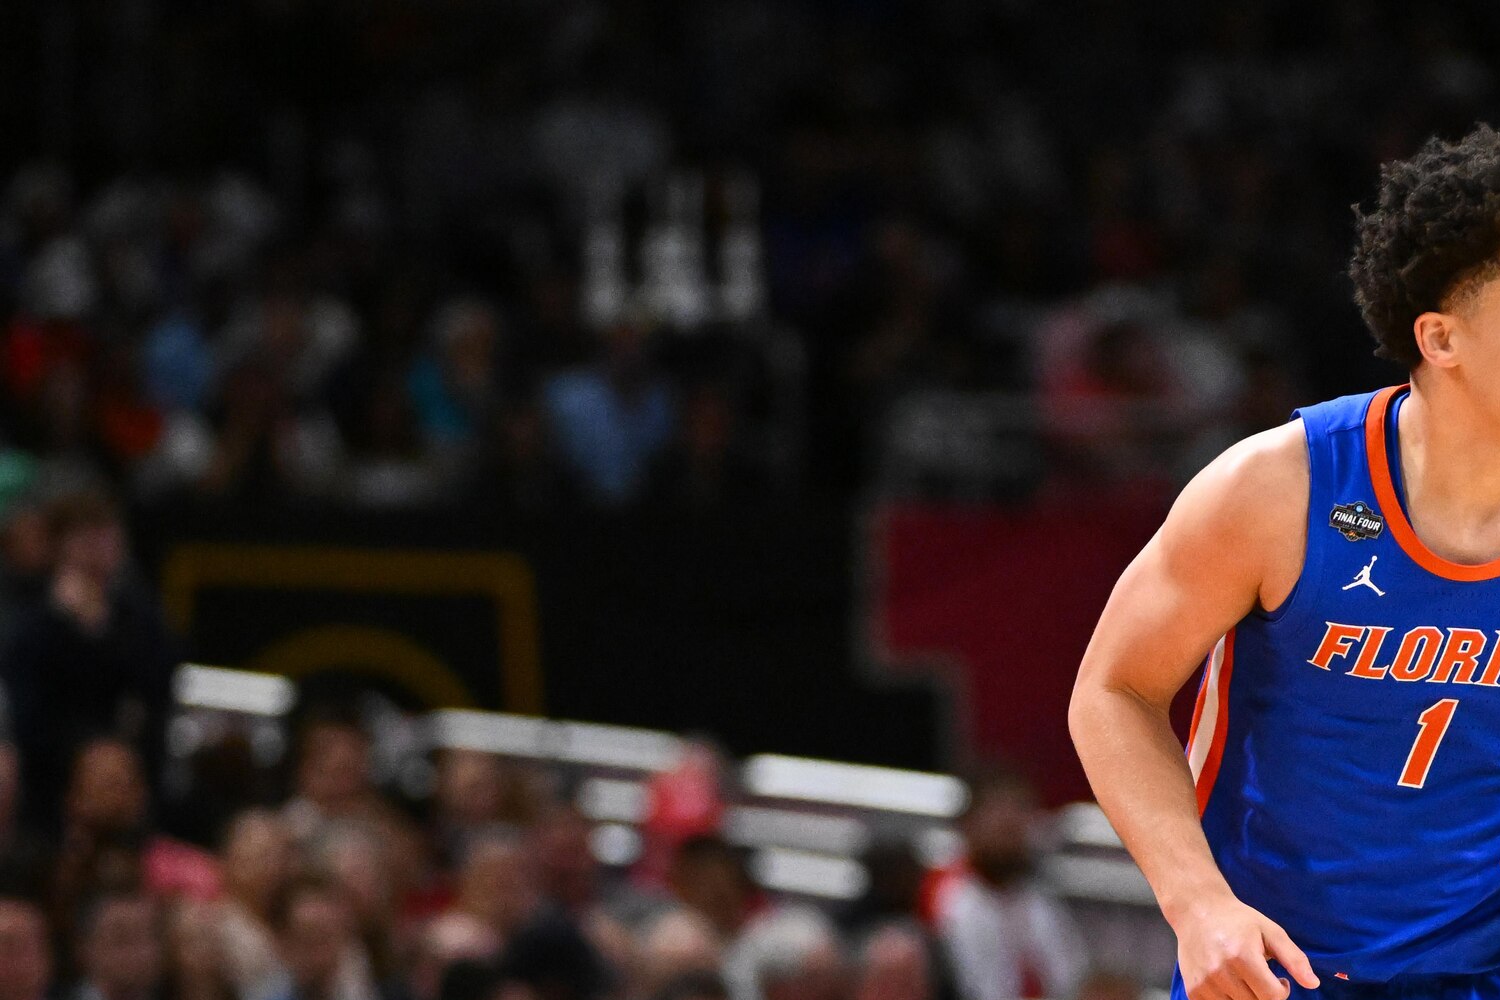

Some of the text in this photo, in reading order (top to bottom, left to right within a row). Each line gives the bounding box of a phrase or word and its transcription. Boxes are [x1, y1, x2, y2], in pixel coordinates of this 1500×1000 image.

[1332, 510, 1357, 526] FINAL
[1356, 517, 1381, 532] FOUR
[1397, 698, 1460, 789] 1
